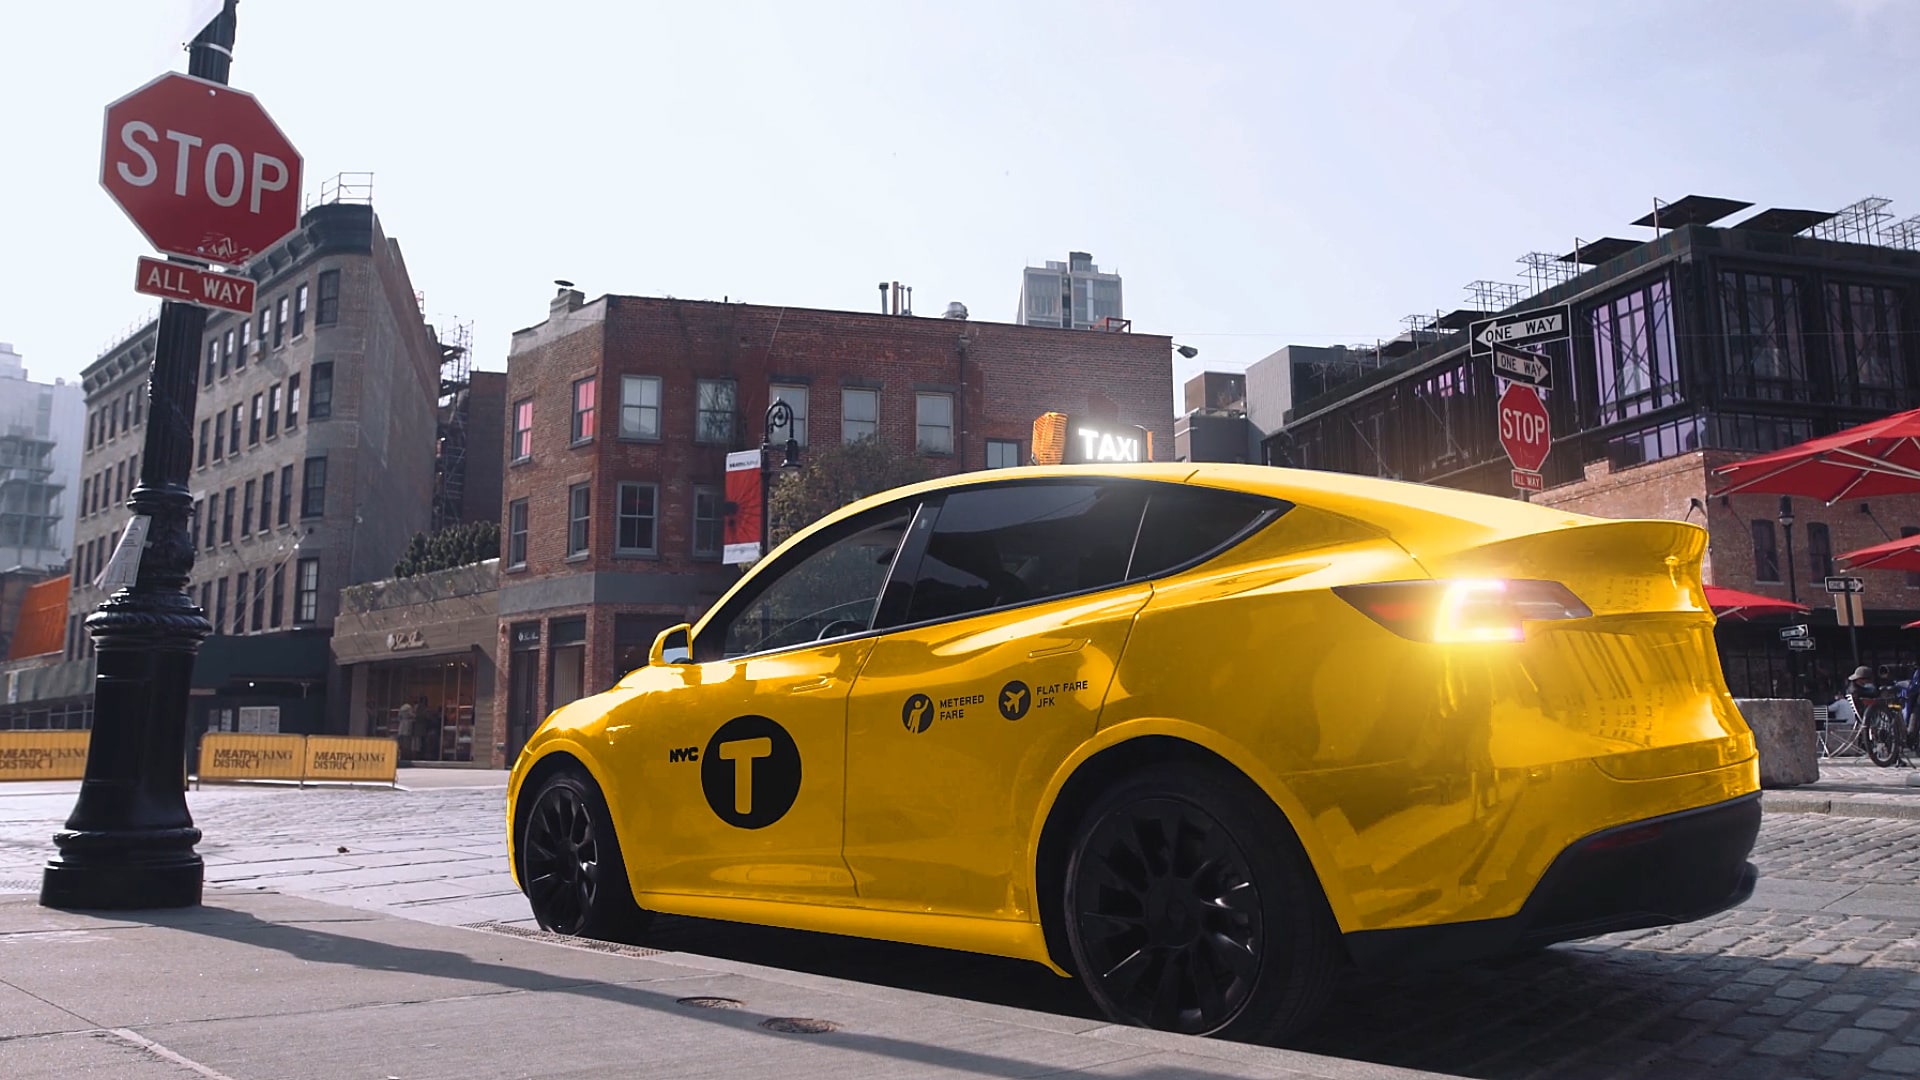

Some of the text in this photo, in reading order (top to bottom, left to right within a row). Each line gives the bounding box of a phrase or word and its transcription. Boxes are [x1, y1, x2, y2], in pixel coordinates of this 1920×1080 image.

[117, 120, 289, 214] STOP
[146, 267, 247, 304] ALL WAY
[1485, 317, 1555, 343] ONE WAY
[1500, 354, 1542, 377] ONE WAY
[1502, 407, 1545, 446] STOP
[1078, 428, 1138, 462] TAXI
[1514, 473, 1540, 488] ALL WAY
[1036, 680, 1088, 696] FLAT FARE
[939, 694, 984, 709] METERED
[1036, 697, 1055, 709] JFK
[939, 709, 964, 721] FARE
[214, 749, 293, 760] MEATPACKING
[314, 751, 385, 762] MEATPACKING
[669, 746, 699, 763] NYC
[213, 759, 260, 769] DISTRICT
[313, 760, 355, 770] DISTRICT
[719, 736, 772, 815] T
